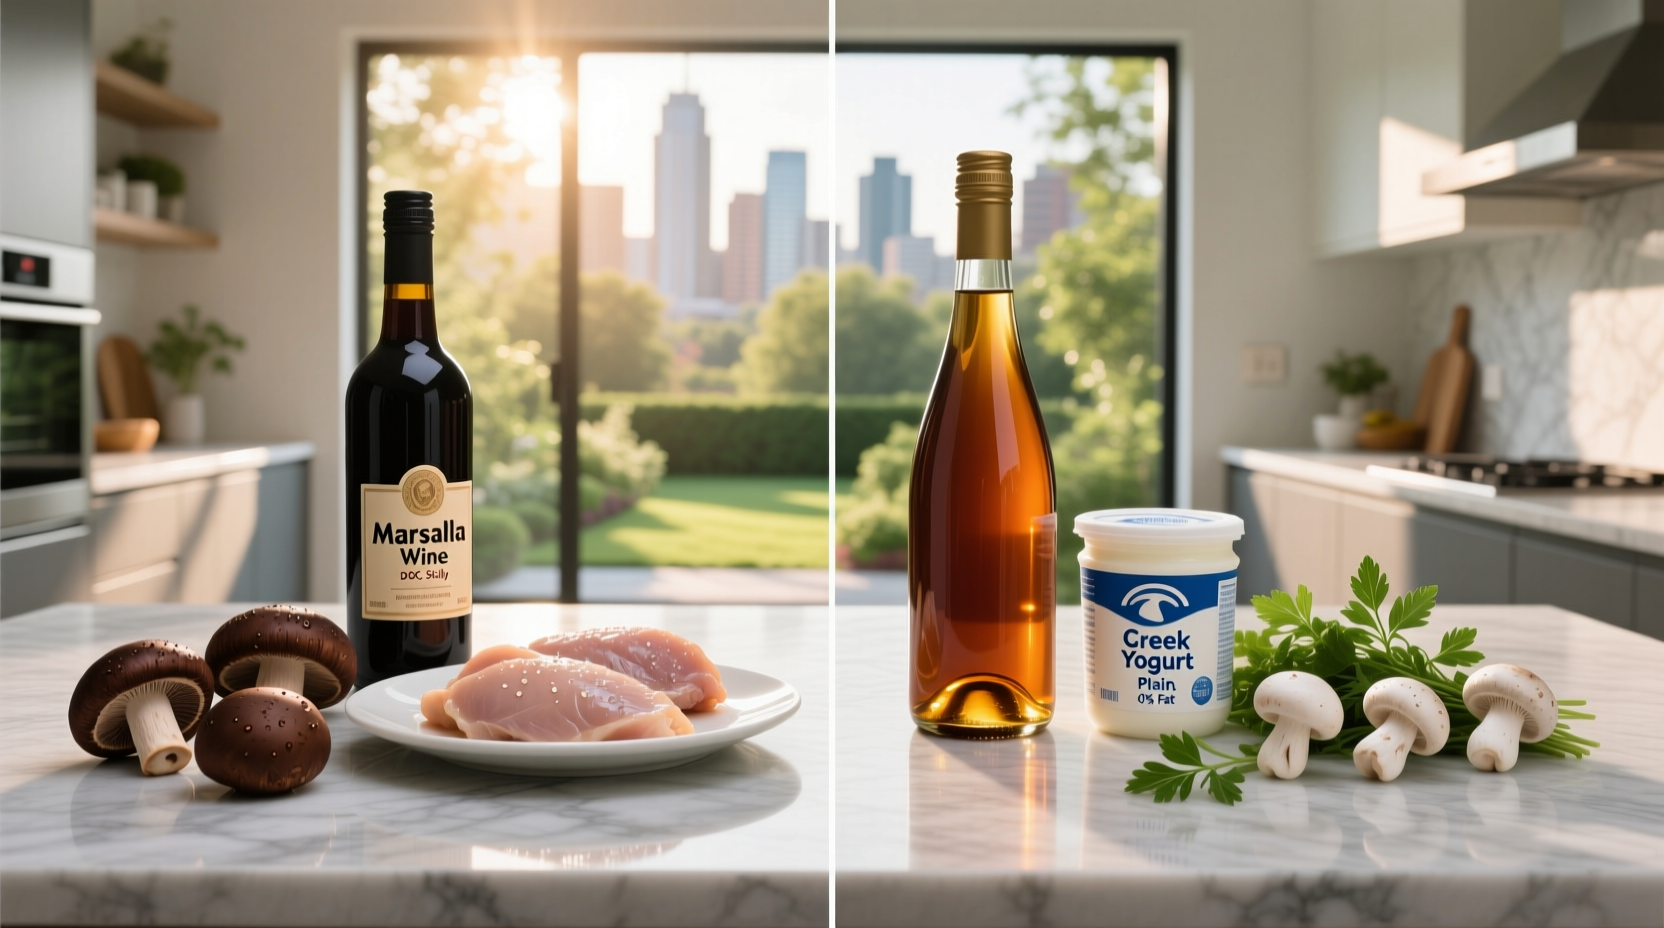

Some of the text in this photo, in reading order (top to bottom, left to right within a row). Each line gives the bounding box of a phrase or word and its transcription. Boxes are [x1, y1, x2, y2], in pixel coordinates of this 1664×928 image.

[372, 519, 466, 545] Marsalla
[399, 547, 449, 566] Wine
[1121, 649, 1194, 675] Yogurt
[1138, 677, 1176, 691] Plain
[1137, 693, 1175, 705] 0% Fat
